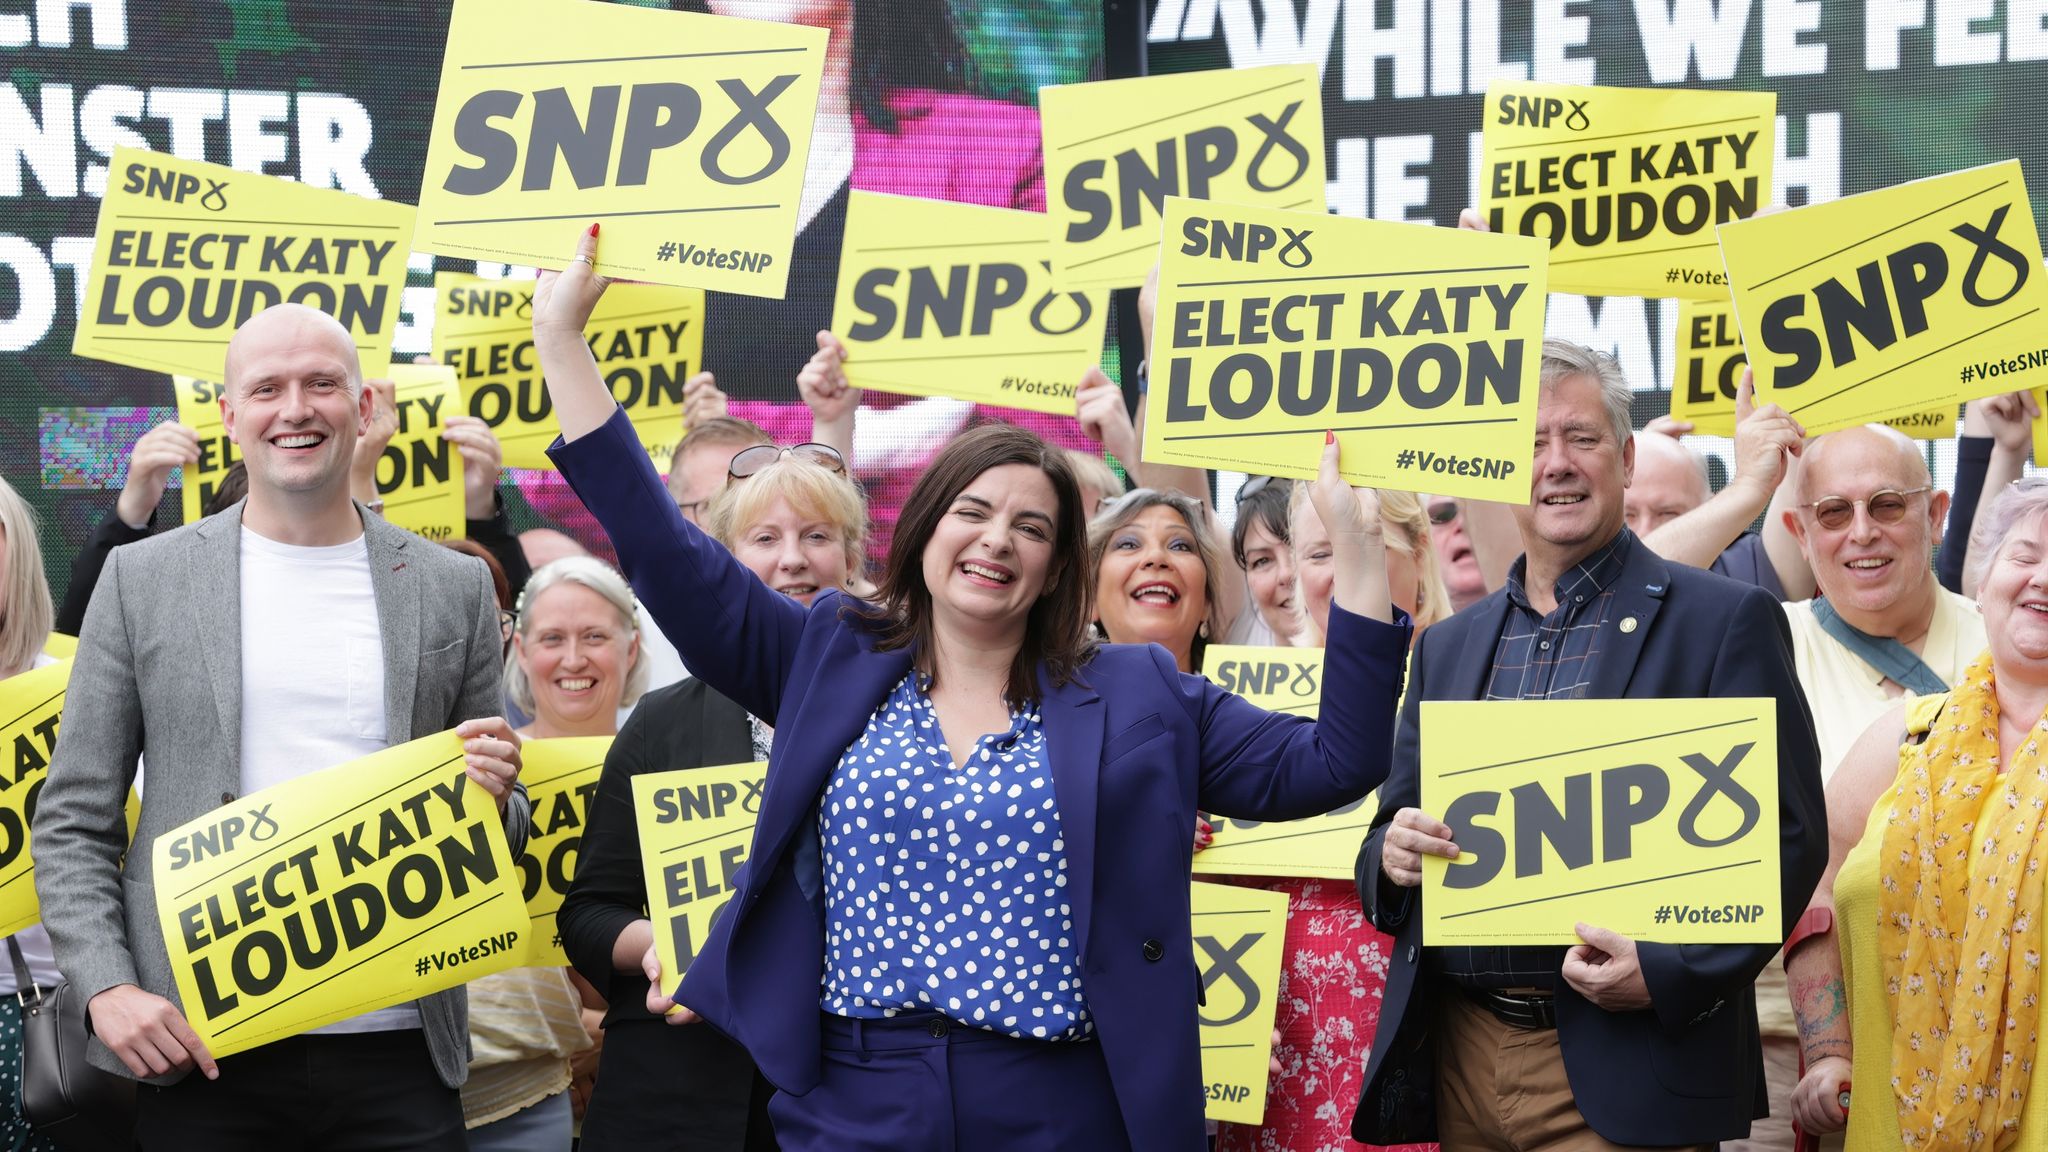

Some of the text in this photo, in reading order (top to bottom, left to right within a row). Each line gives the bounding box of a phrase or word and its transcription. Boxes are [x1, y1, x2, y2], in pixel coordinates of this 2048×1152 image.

[1498, 94, 1564, 129] SNP
[442, 82, 702, 196] SNP
[1491, 150, 1617, 199] ELECT
[1630, 130, 1760, 183] KATY
[123, 163, 201, 205] SNP
[1062, 125, 1239, 243] SNP
[107, 230, 250, 271] ELECT
[259, 236, 397, 276] KATY
[657, 241, 773, 274] #VoteSNP
[1181, 216, 1278, 263] SNP
[448, 288, 513, 318] SNP
[847, 262, 1027, 343] SNP
[1172, 283, 1529, 348] ELECT KATY
[1759, 241, 1950, 390] SNP
[1166, 339, 1525, 423] LOUDON
[1395, 449, 1516, 481] #VoteSNP
[1216, 660, 1291, 696] SNP
[653, 782, 738, 824] SNP
[1441, 763, 1671, 889] SNP
[169, 811, 246, 871] SNP
[178, 845, 319, 955] ELECT
[331, 772, 468, 878] KATY
[191, 821, 500, 1022] LOUDON
[1654, 904, 1765, 925] #VoteSNP
[414, 931, 519, 978] #VoteSNP
